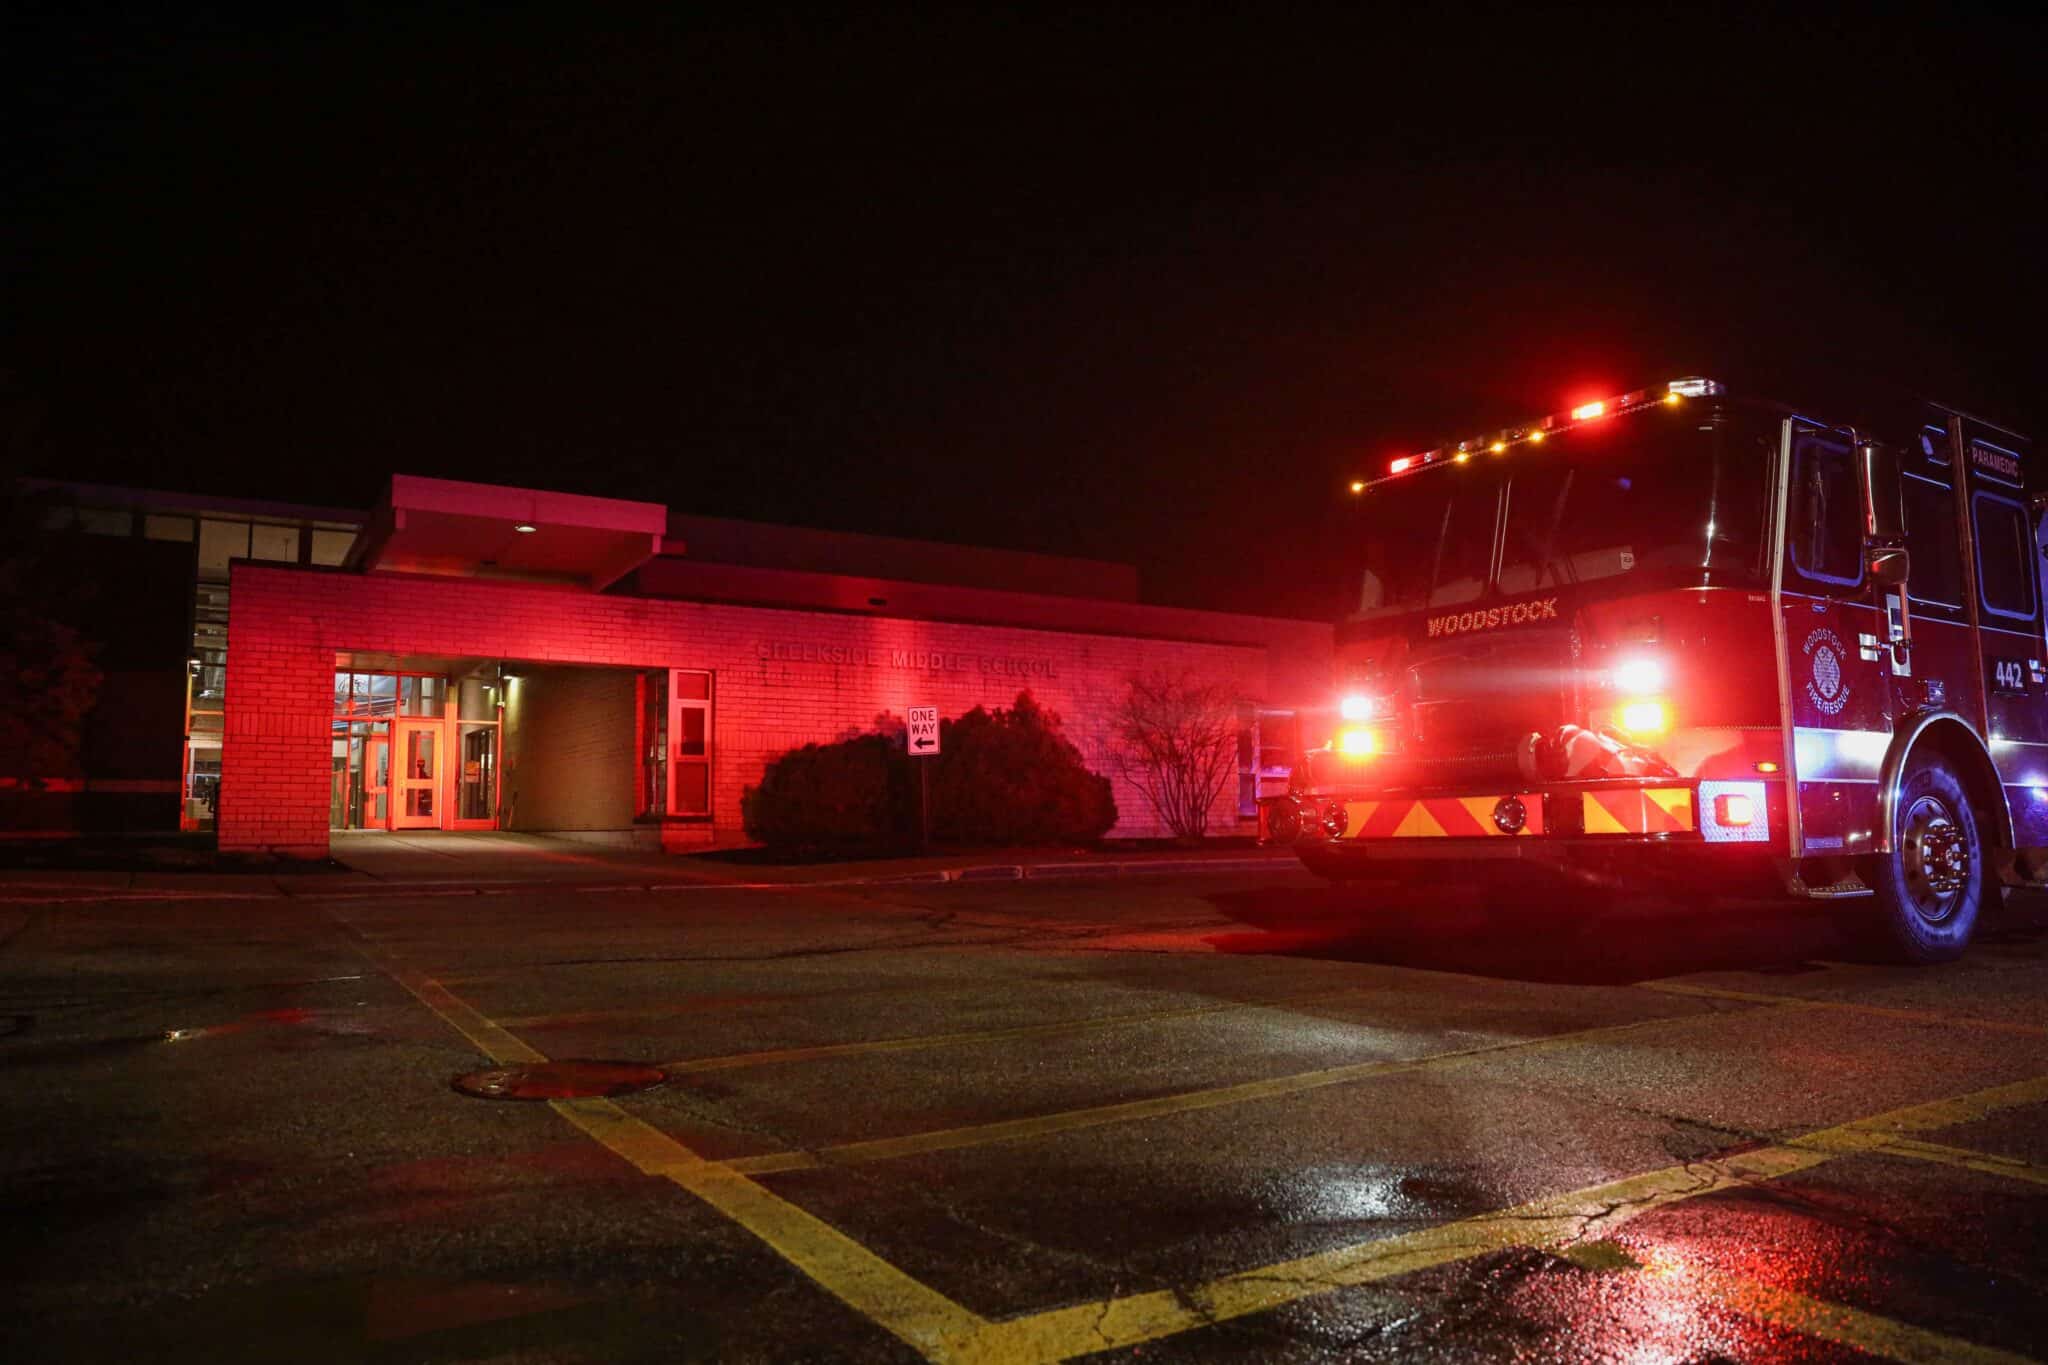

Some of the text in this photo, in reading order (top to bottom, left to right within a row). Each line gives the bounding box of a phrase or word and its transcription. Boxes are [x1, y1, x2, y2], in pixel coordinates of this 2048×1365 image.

[1427, 598, 1558, 637] WOODSTOCK
[1802, 628, 1847, 661] WOODSTOCK
[891, 650, 968, 673] MIDDLE
[977, 656, 1057, 679] SCHOOL
[1996, 661, 2023, 688] 442
[911, 710, 935, 721] ONE
[911, 723, 935, 735] WAY
